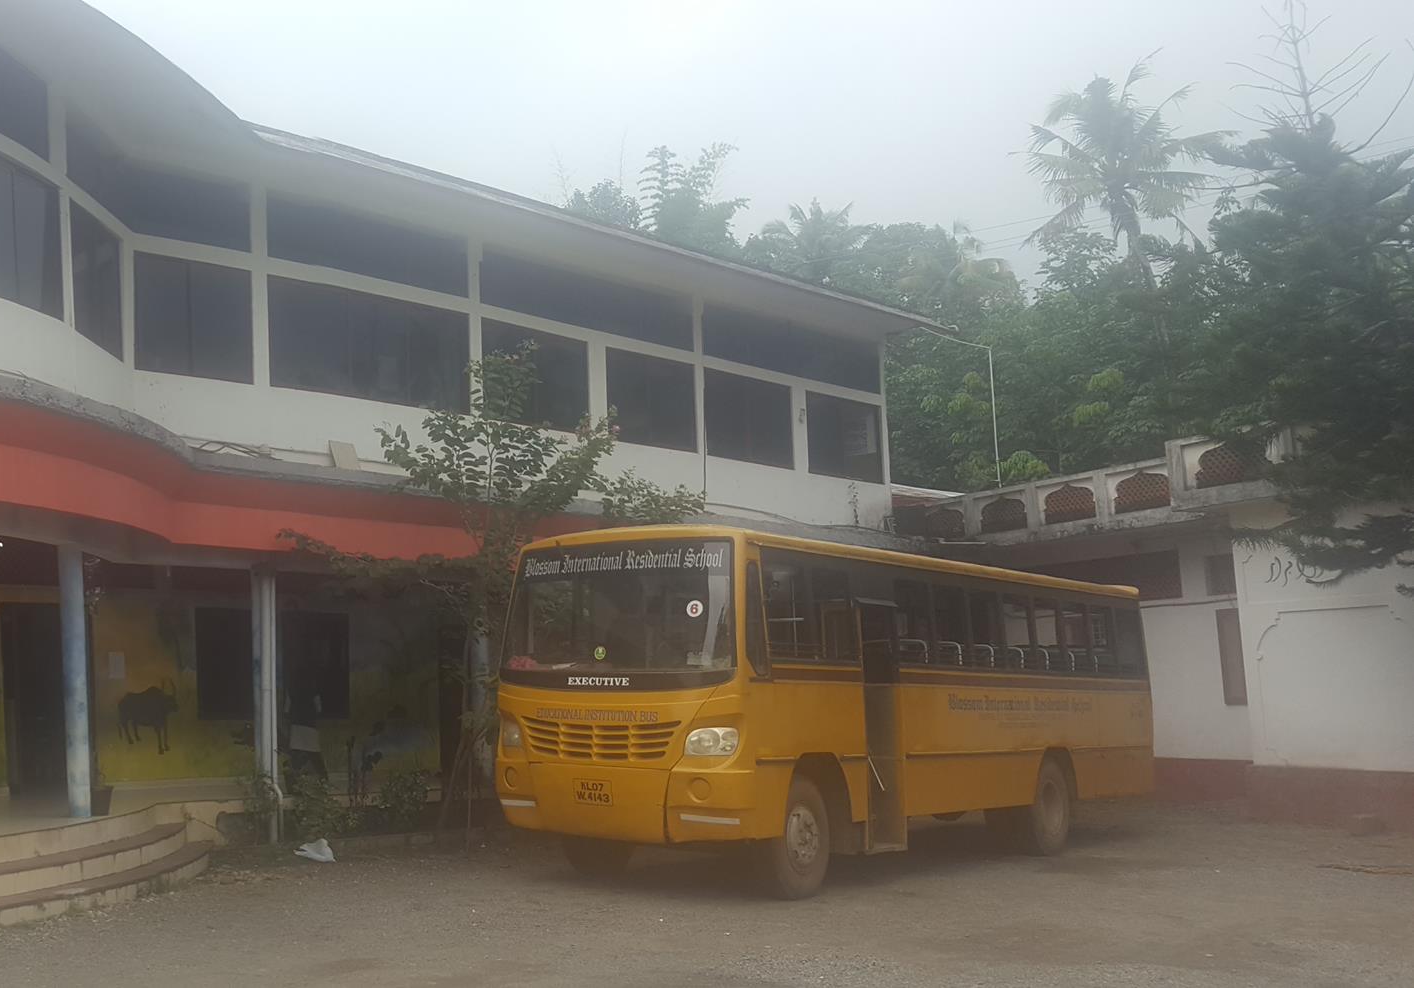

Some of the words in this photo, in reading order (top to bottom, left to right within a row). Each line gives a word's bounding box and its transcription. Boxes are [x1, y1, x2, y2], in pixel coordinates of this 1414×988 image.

[524, 558, 561, 577] Blossom
[561, 551, 623, 574] International
[624, 549, 681, 570] Residential
[682, 547, 724, 571] School
[690, 603, 698, 614] 6
[567, 676, 630, 686] EXECUTIVE
[583, 708, 637, 722] INSTITUTION
[639, 710, 659, 723] BUS
